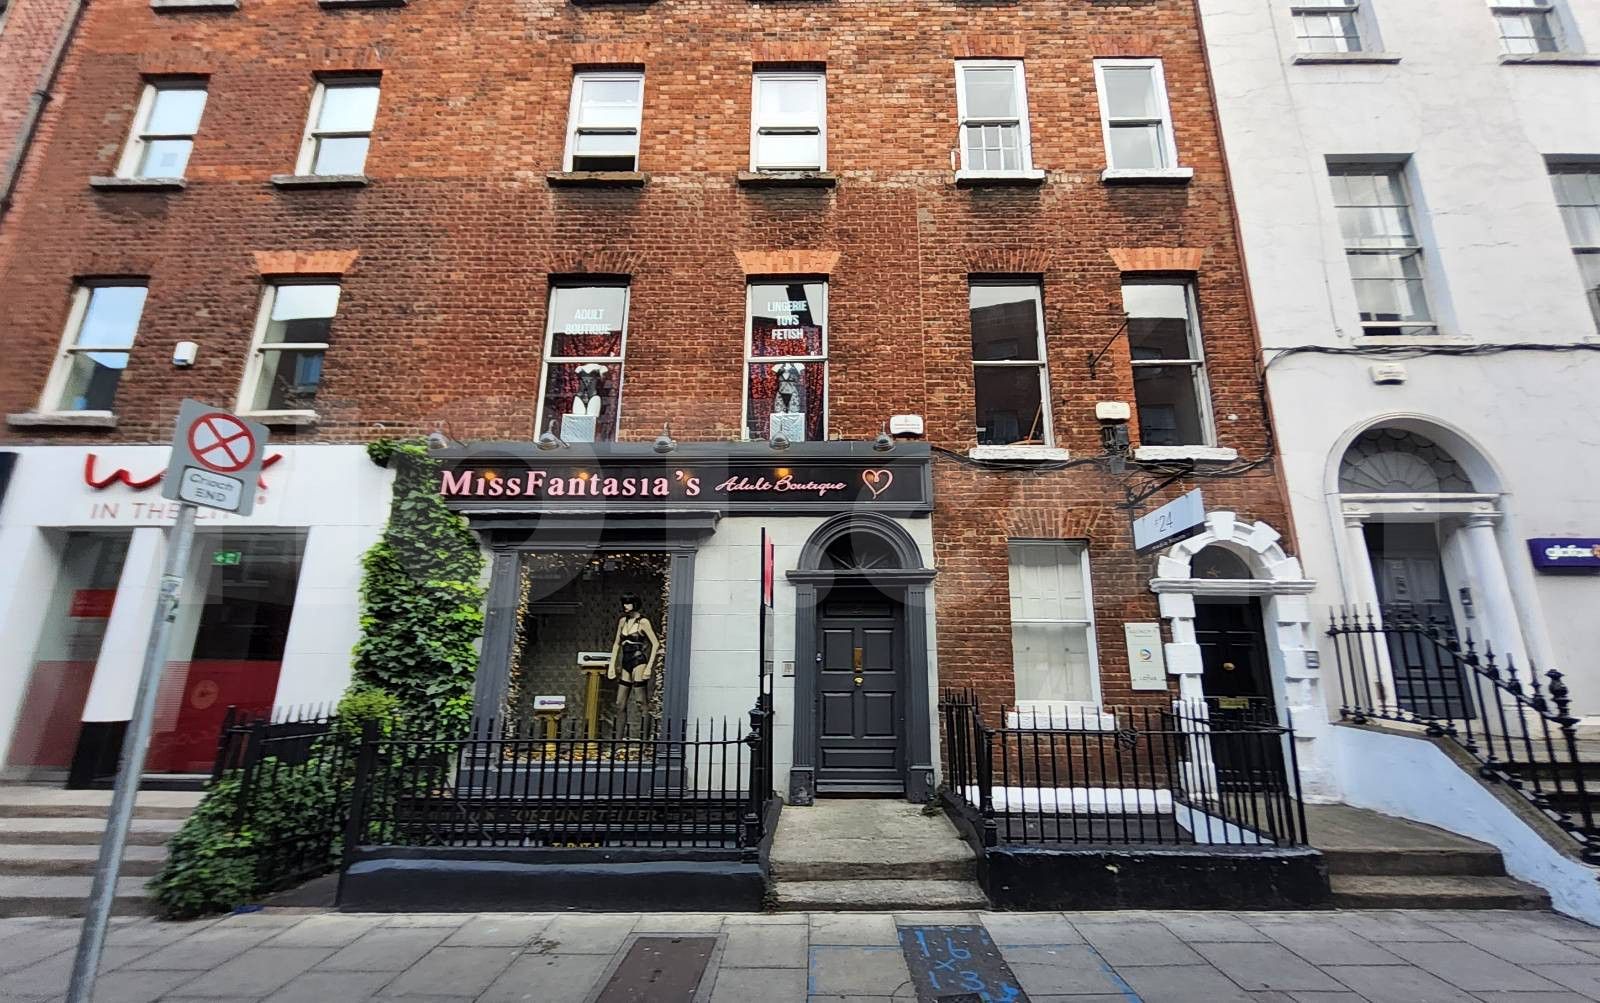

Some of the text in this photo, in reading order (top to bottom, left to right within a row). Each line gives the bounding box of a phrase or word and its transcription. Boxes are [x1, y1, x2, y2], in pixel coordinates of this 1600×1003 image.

[767, 300, 808, 313] LINGERIE
[574, 308, 605, 321] ADULT
[776, 314, 800, 327] TOYS
[564, 323, 613, 335] BOUTIQUE
[771, 328, 805, 341] FETISH
[440, 469, 847, 498] MissFantasia's Adult Boutique
[194, 487, 227, 502] END
[90, 503, 119, 520] IN
